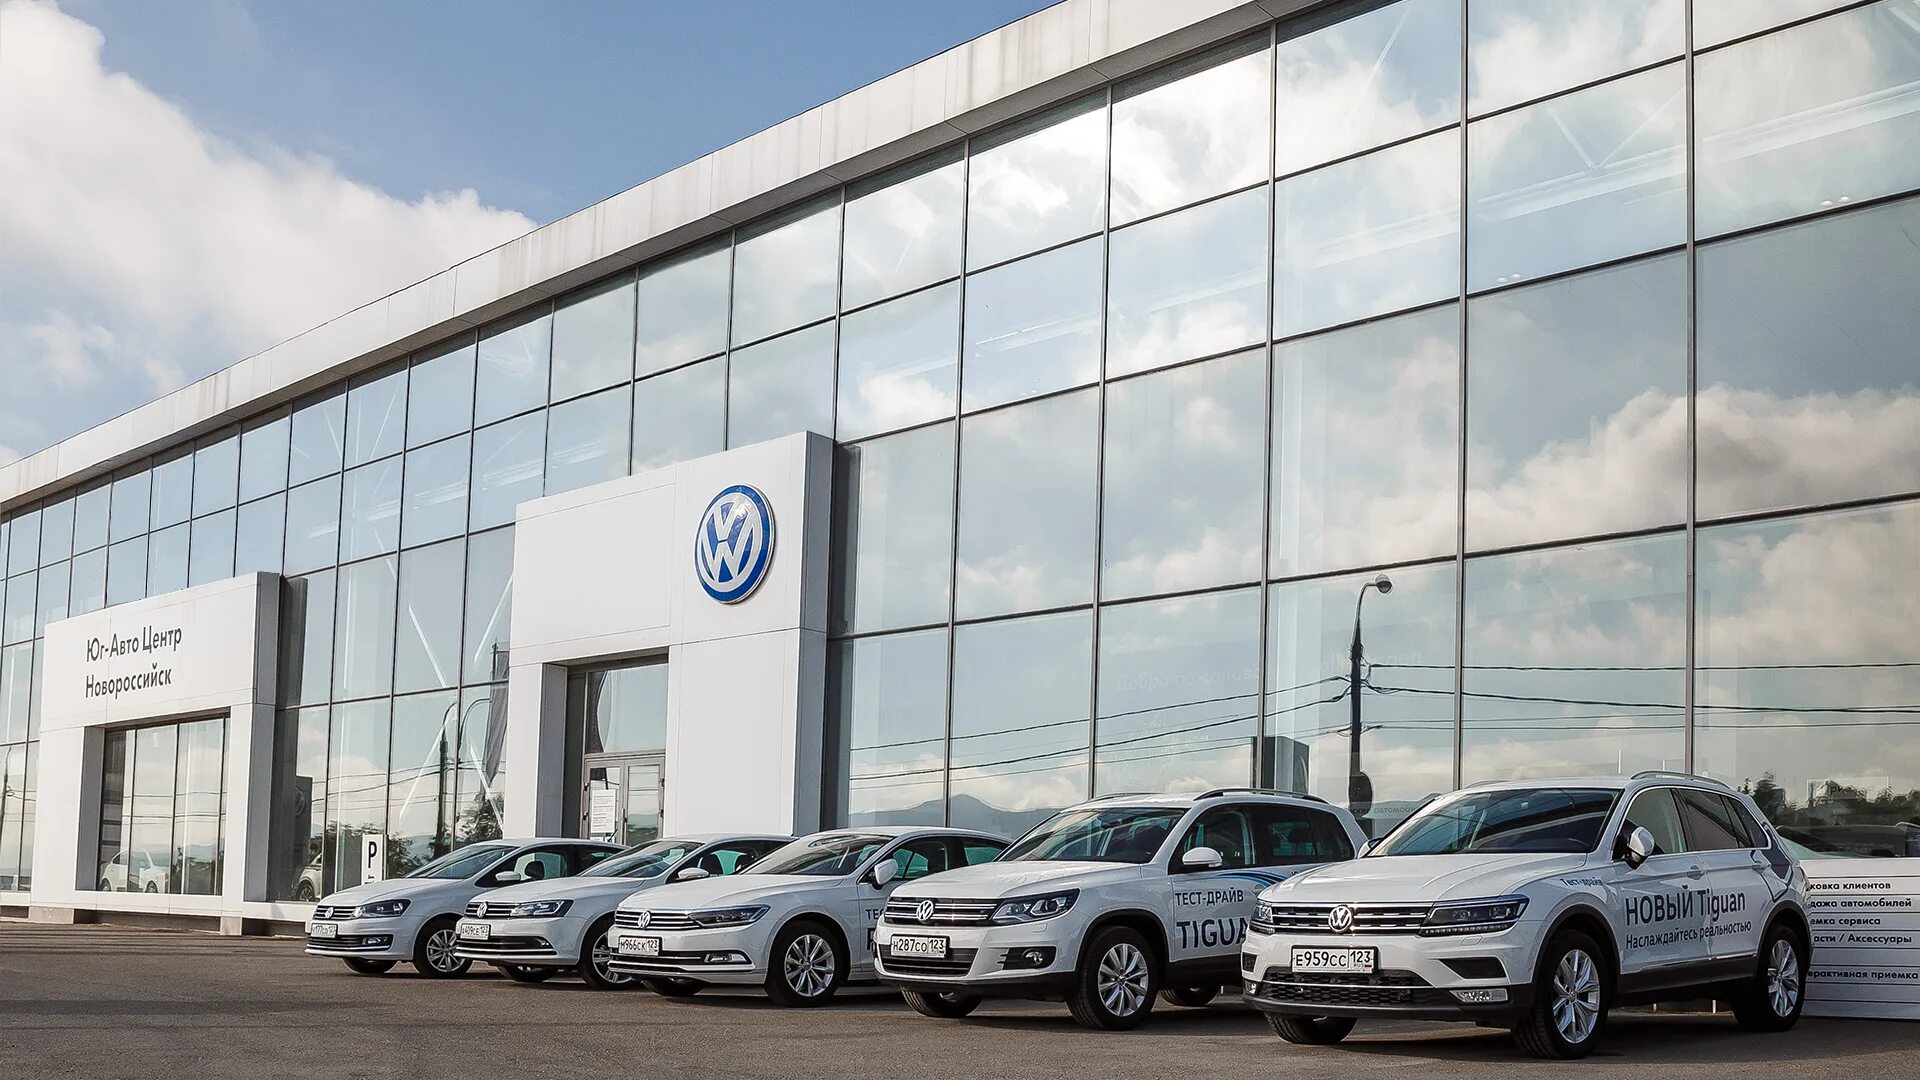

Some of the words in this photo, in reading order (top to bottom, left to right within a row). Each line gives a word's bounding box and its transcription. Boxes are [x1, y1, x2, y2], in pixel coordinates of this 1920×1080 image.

[86, 633, 139, 662] Юг-Авто
[142, 625, 182, 653] Центр
[85, 662, 172, 700] Новороссийск
[367, 841, 378, 869] P
[1843, 882, 1891, 890] клиентов
[1175, 887, 1244, 906] ТЕСТ-ДРАЙВ
[1840, 897, 1912, 907] автомобилей
[1625, 884, 1694, 926] НОВЫЙ
[1697, 889, 1746, 922] Tiguan
[1838, 918, 1881, 926] сервиса
[1625, 927, 1698, 950] Наслаждайтесь
[1699, 920, 1752, 943] реальностью
[1847, 933, 1912, 944] Аксессуары
[647, 939, 658, 949] 123
[893, 938, 927, 952] Н287СО
[929, 939, 944, 949] 123
[1296, 951, 1347, 967] Е959СС
[1350, 951, 1371, 963] 123
[1871, 970, 1919, 980] приемка
